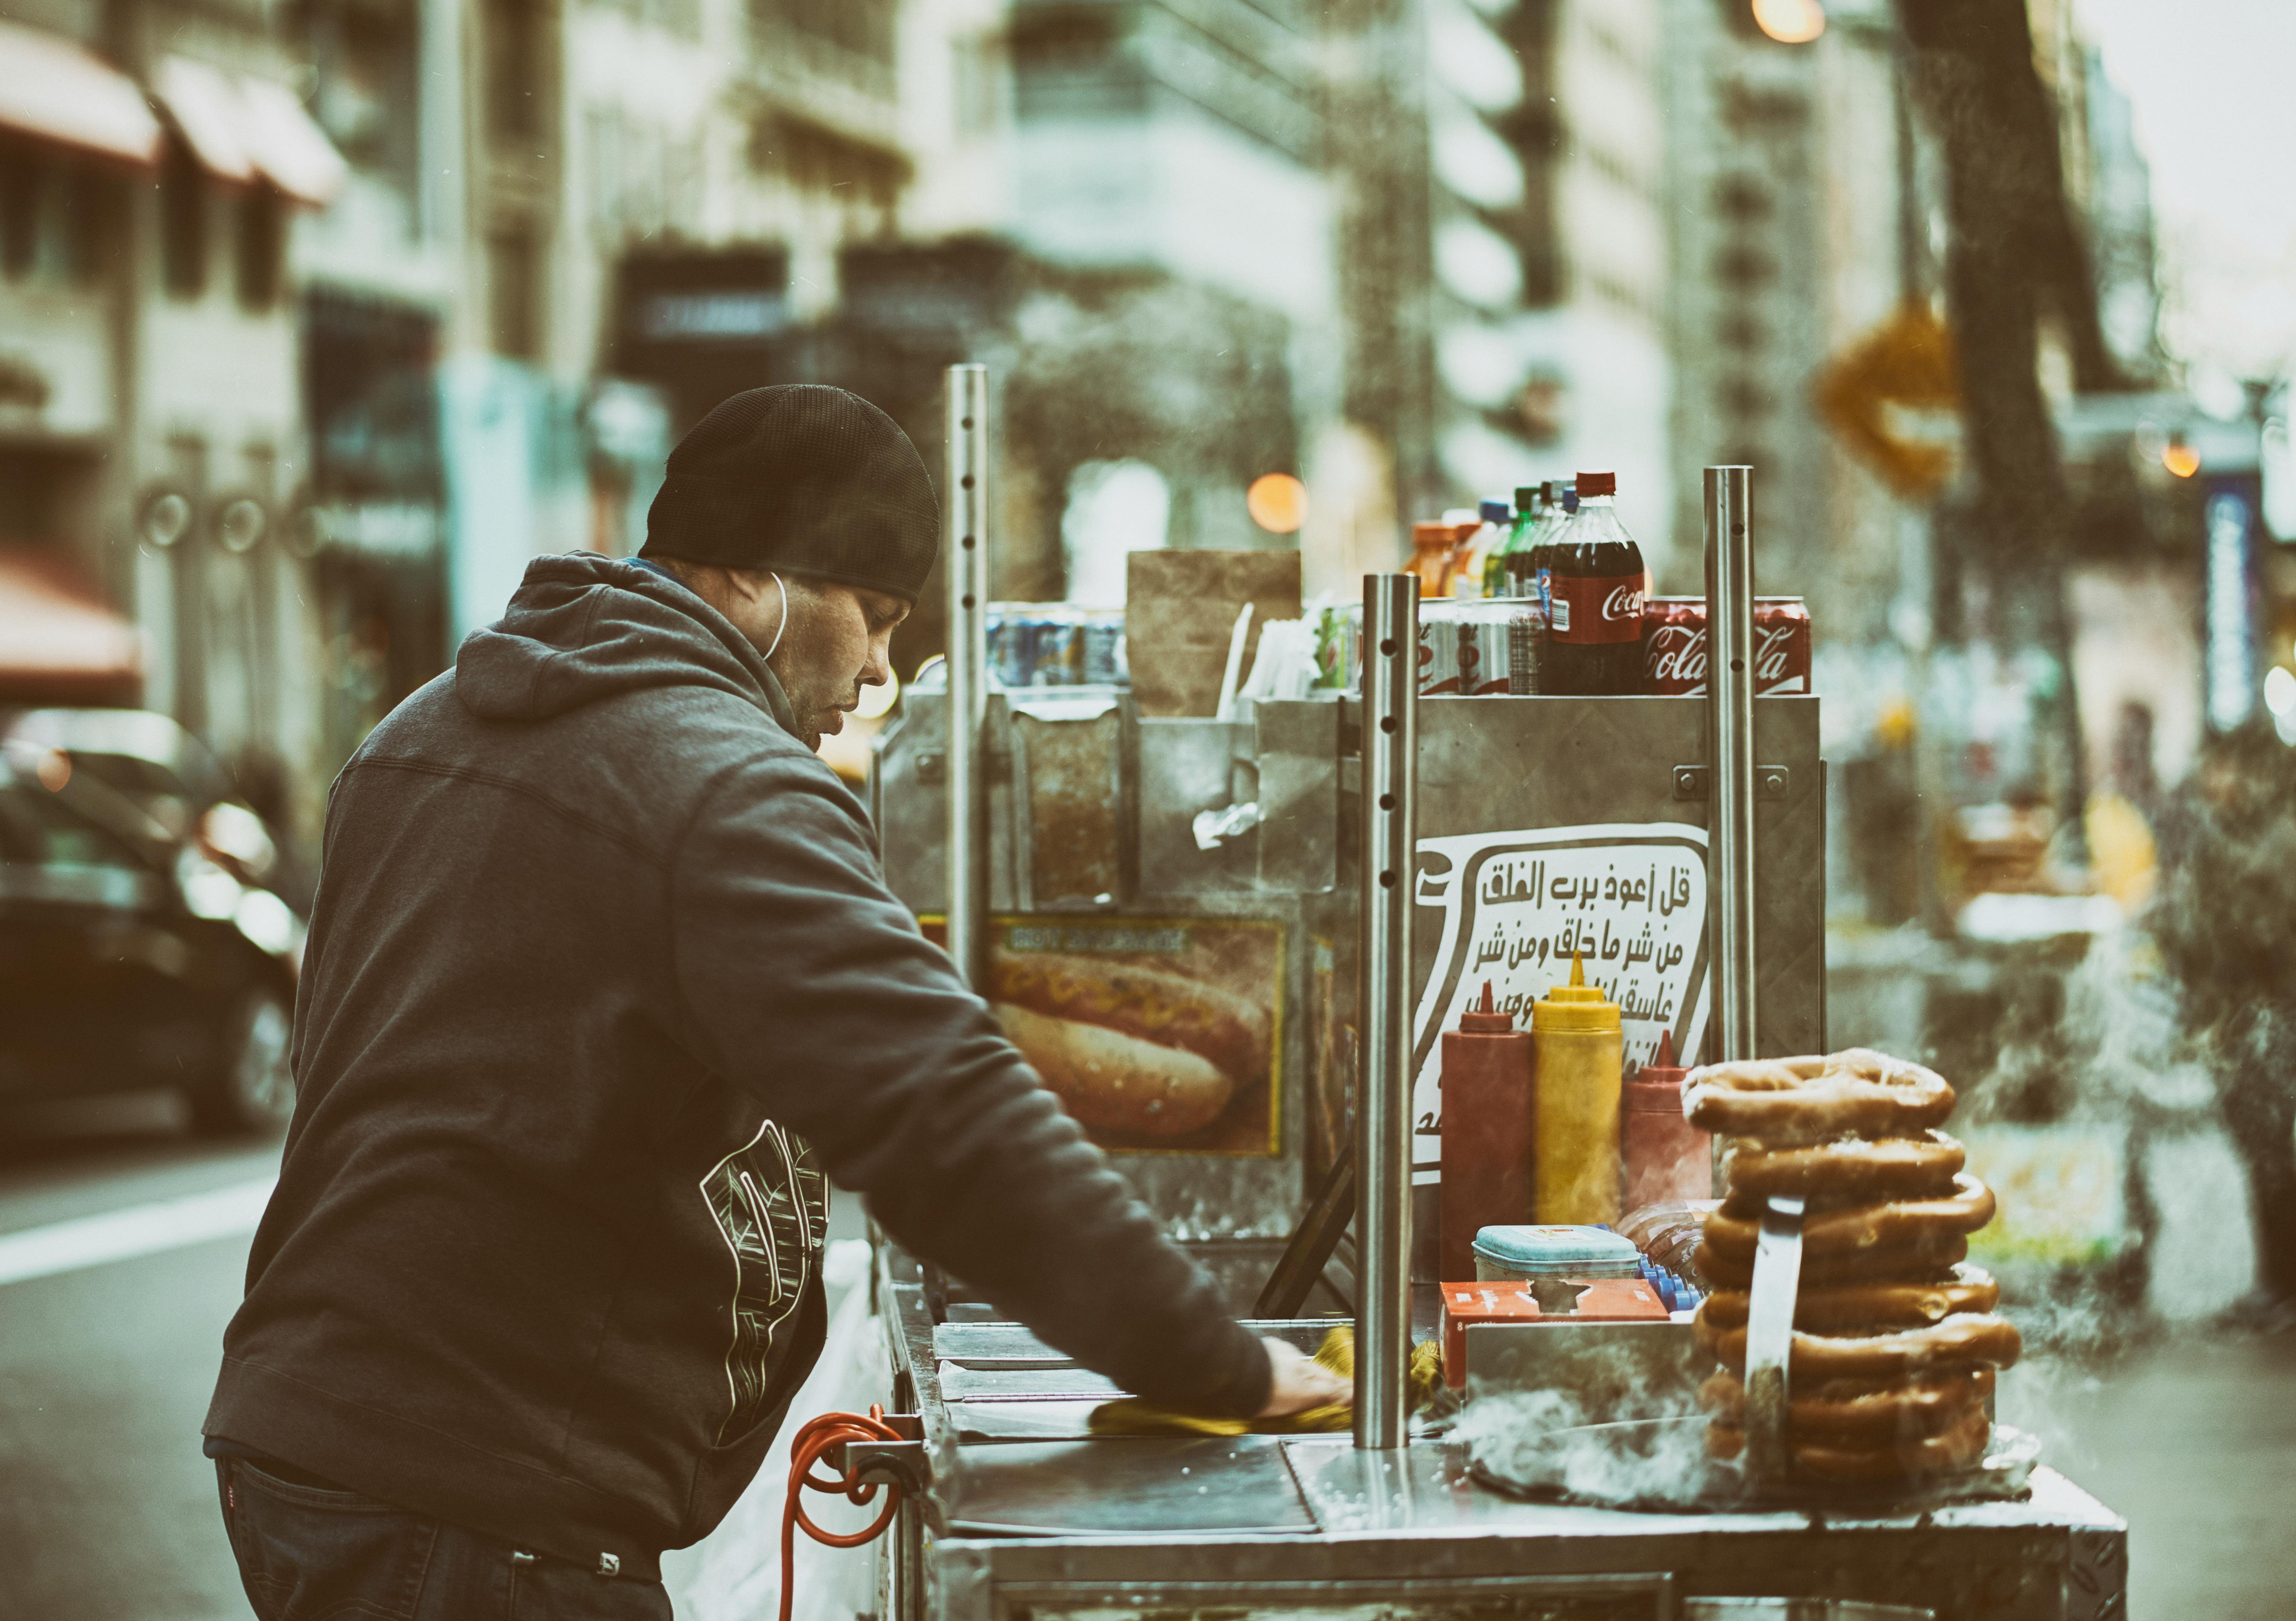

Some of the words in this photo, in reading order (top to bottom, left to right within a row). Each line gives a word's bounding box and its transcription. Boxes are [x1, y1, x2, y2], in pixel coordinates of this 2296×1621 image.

[1602, 585, 1645, 621] Coca
[1755, 625, 1796, 680] la
[1482, 860, 1545, 909] الفلق
[1550, 876, 1598, 910] برب
[1604, 863, 1655, 912] أعوذ
[1660, 866, 1690, 916] قل
[1473, 922, 1506, 973] شر
[1554, 918, 1596, 960] خلق
[1601, 919, 1620, 960] ما
[1622, 922, 1654, 971] شر
[1656, 924, 1683, 973] من
